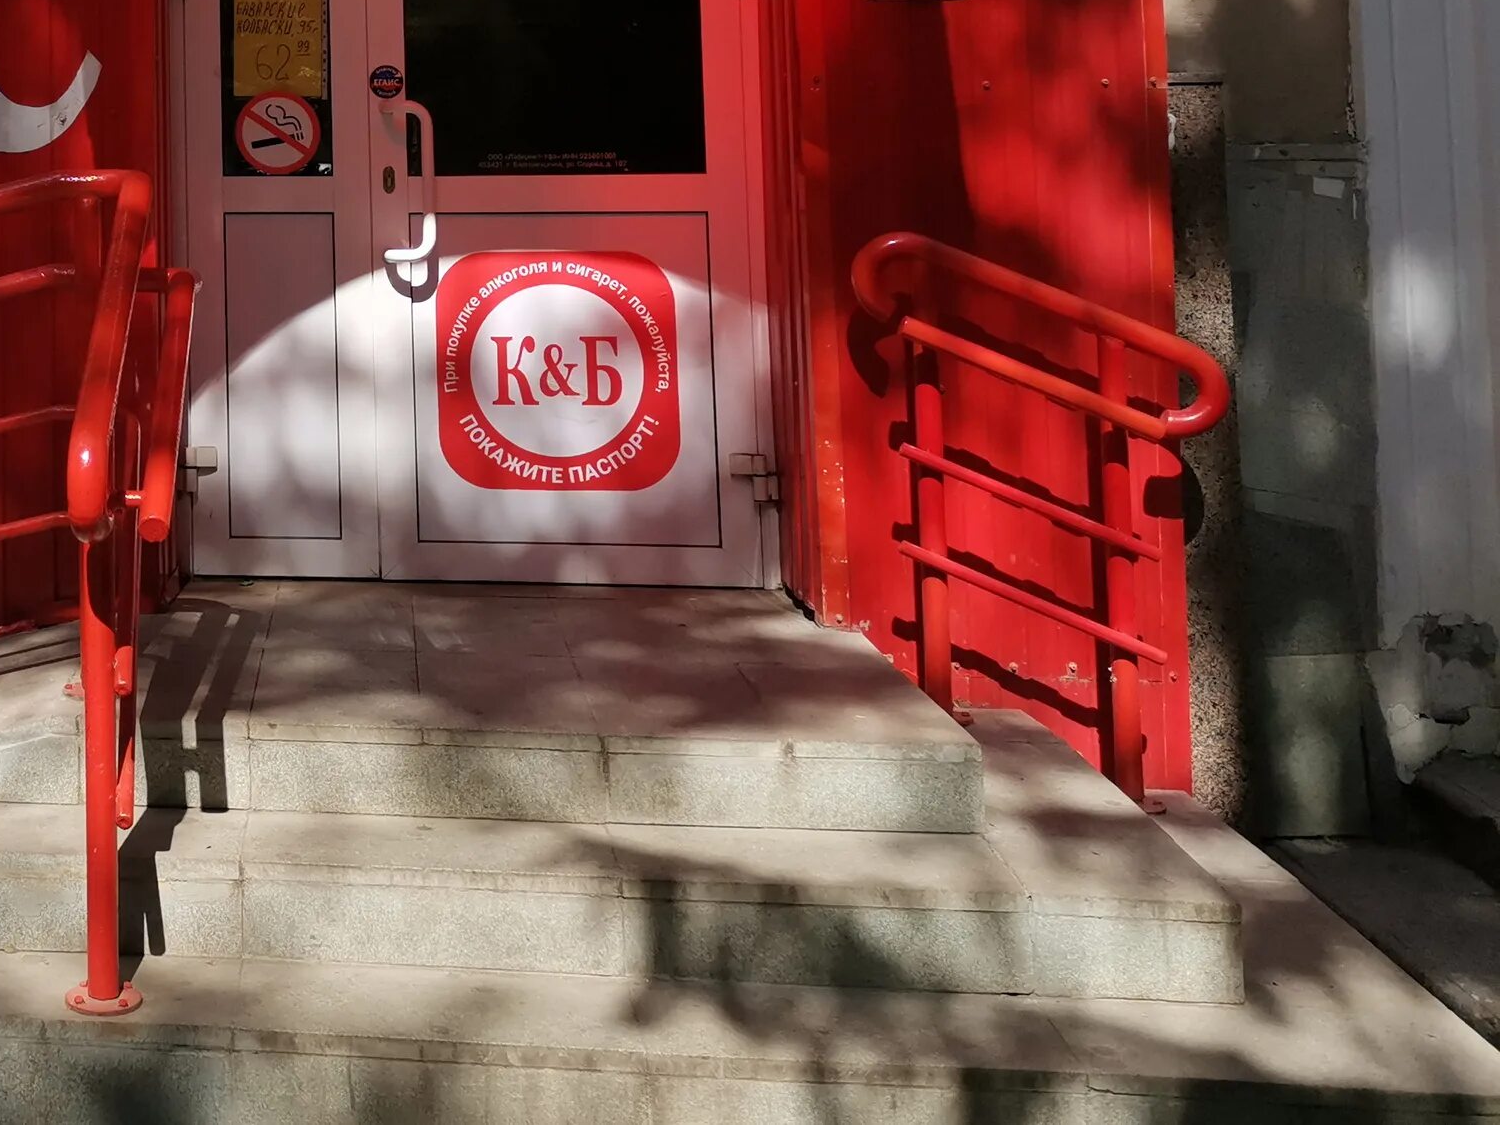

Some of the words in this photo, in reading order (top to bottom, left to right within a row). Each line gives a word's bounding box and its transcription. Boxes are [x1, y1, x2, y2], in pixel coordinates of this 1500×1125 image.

[256, 43, 291, 81] 62
[297, 40, 310, 55] 99
[373, 78, 401, 87] ЕГАИС
[479, 260, 548, 299] алкоголя
[551, 260, 562, 273] и
[566, 261, 628, 300] сигарет,
[447, 296, 481, 358] покупке
[627, 295, 672, 394] пожалуйста,
[444, 361, 460, 393] При
[489, 334, 623, 406] К&Б
[459, 413, 564, 484] ПОКАЖИТЕ
[568, 414, 661, 484] ПАСПОРТ!
